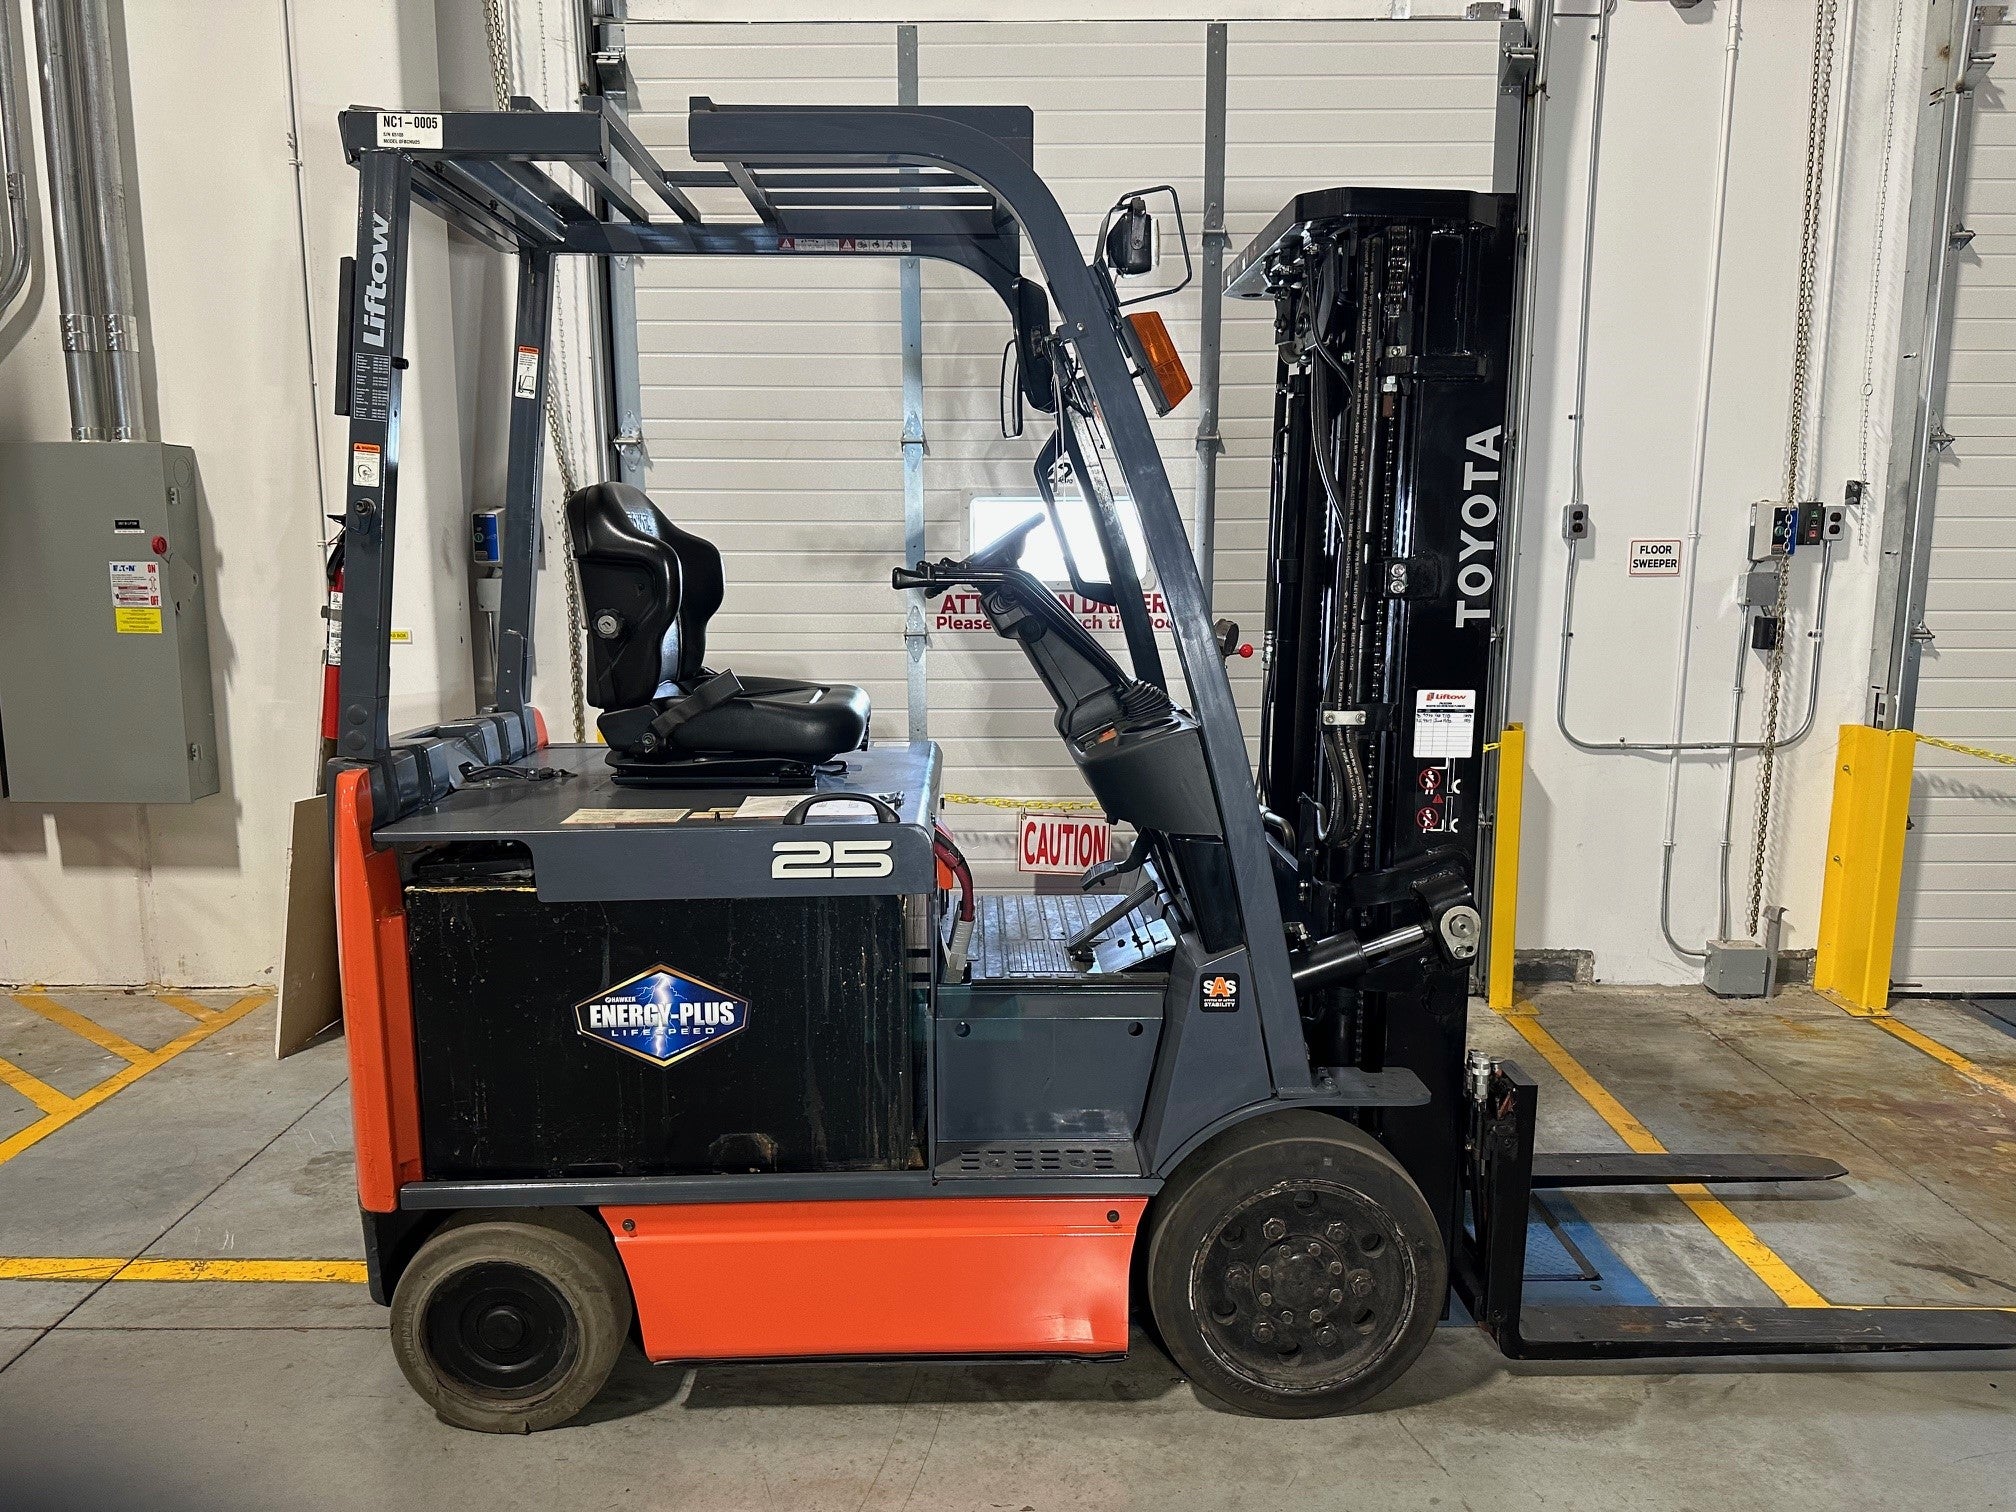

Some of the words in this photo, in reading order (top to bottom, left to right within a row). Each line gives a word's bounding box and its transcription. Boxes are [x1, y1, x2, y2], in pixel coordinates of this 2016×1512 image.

[363, 212, 390, 348] Liftow
[1455, 425, 1501, 628] TOYOTA
[1639, 545, 1672, 555] FLOOR
[147, 564, 156, 573] ON
[1632, 559, 1677, 568] SWEEPER
[936, 616, 991, 630] Please
[1024, 821, 1106, 868] CAUTION
[771, 840, 893, 878] 25
[1203, 976, 1237, 998] SAS
[589, 1001, 735, 1028] ENERGY-PLUS
[611, 1028, 715, 1036] LIFESPEED
